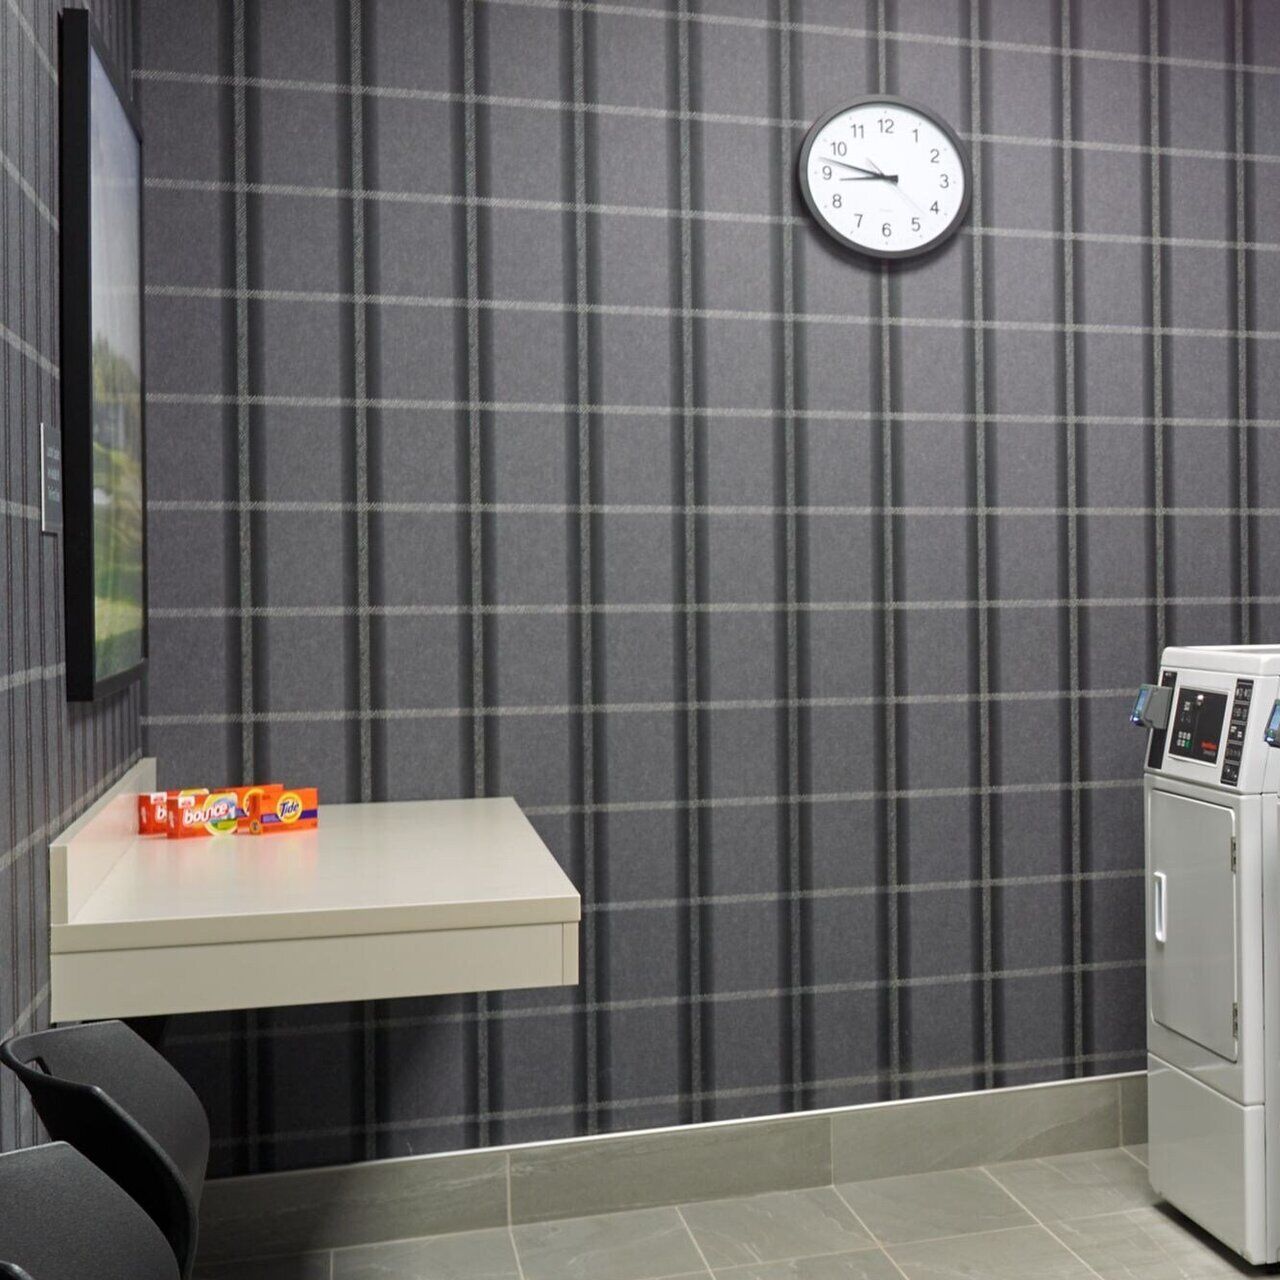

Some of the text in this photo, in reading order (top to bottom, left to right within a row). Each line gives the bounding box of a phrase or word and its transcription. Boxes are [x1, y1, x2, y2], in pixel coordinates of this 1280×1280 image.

[851, 124, 865, 138] 11
[878, 119, 894, 134] 12
[912, 129, 919, 143] 1
[831, 142, 847, 156] 10
[930, 149, 940, 163] 2
[822, 166, 832, 180] 9
[939, 174, 949, 188] 3
[832, 194, 842, 208] 8
[930, 200, 940, 214] 4
[853, 214, 864, 228] 7
[911, 217, 921, 232] 5
[881, 223, 892, 237] 6
[183, 802, 229, 825] bounce
[278, 800, 300, 818] Tide
